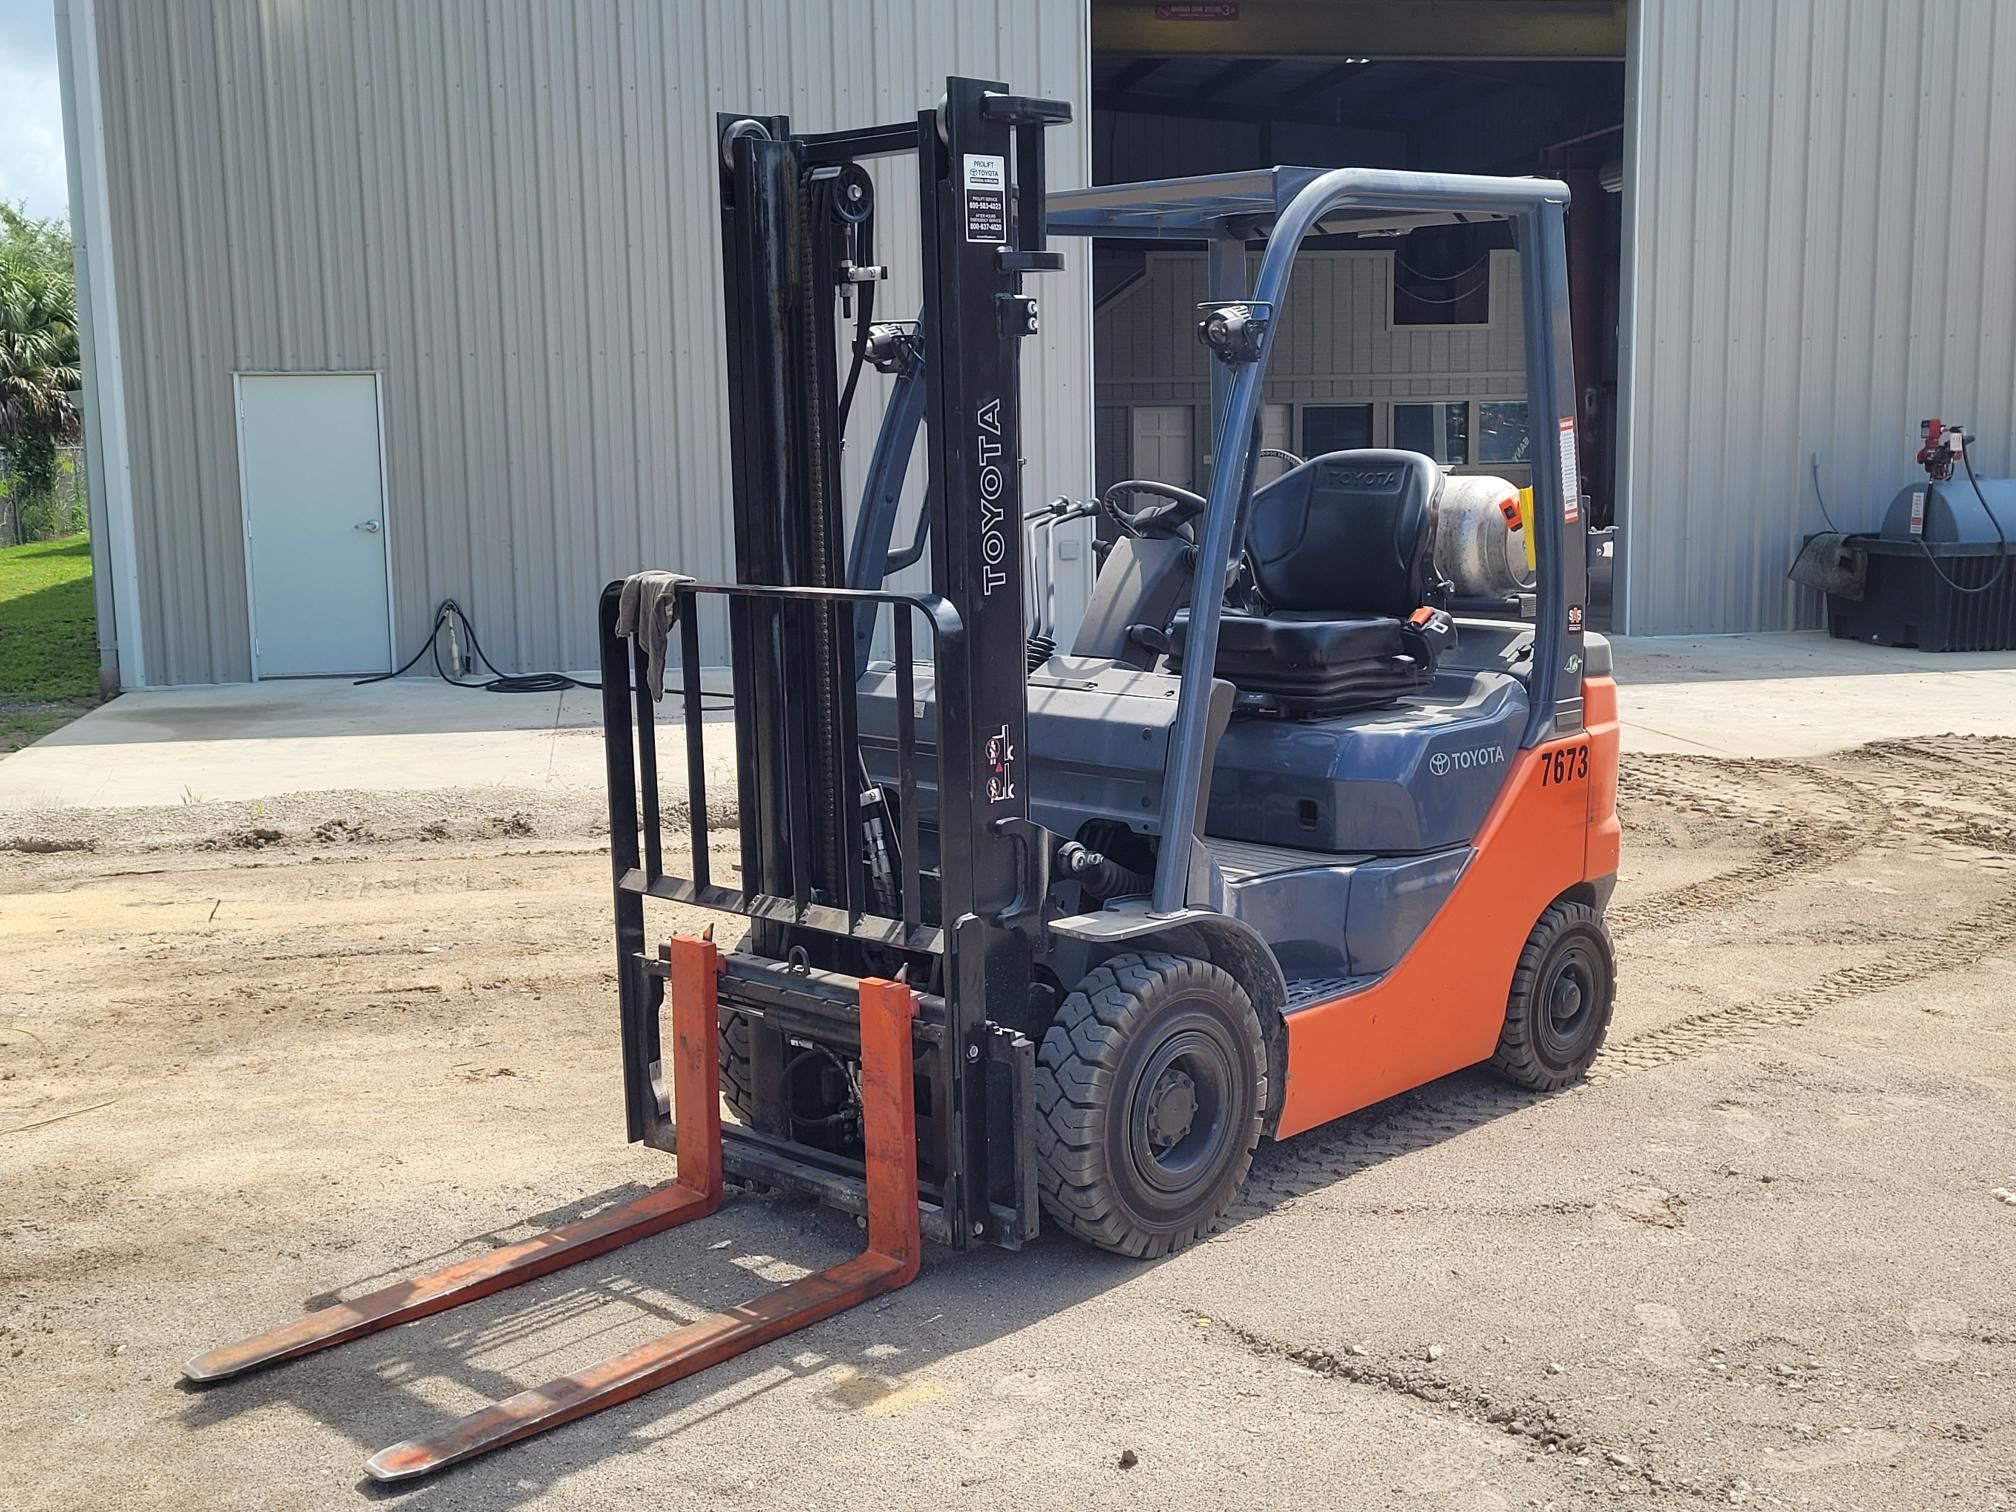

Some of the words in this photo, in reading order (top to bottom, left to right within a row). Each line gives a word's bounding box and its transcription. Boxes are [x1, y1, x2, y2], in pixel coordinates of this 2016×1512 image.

[973, 160, 994, 168] PROLIFT
[978, 169, 999, 177] TOYOTA
[1328, 471, 1394, 486] TOYOTA
[978, 398, 1006, 596] TOYOTA
[1451, 746, 1505, 770] TOYOTA
[1541, 744, 1588, 787] 7673
